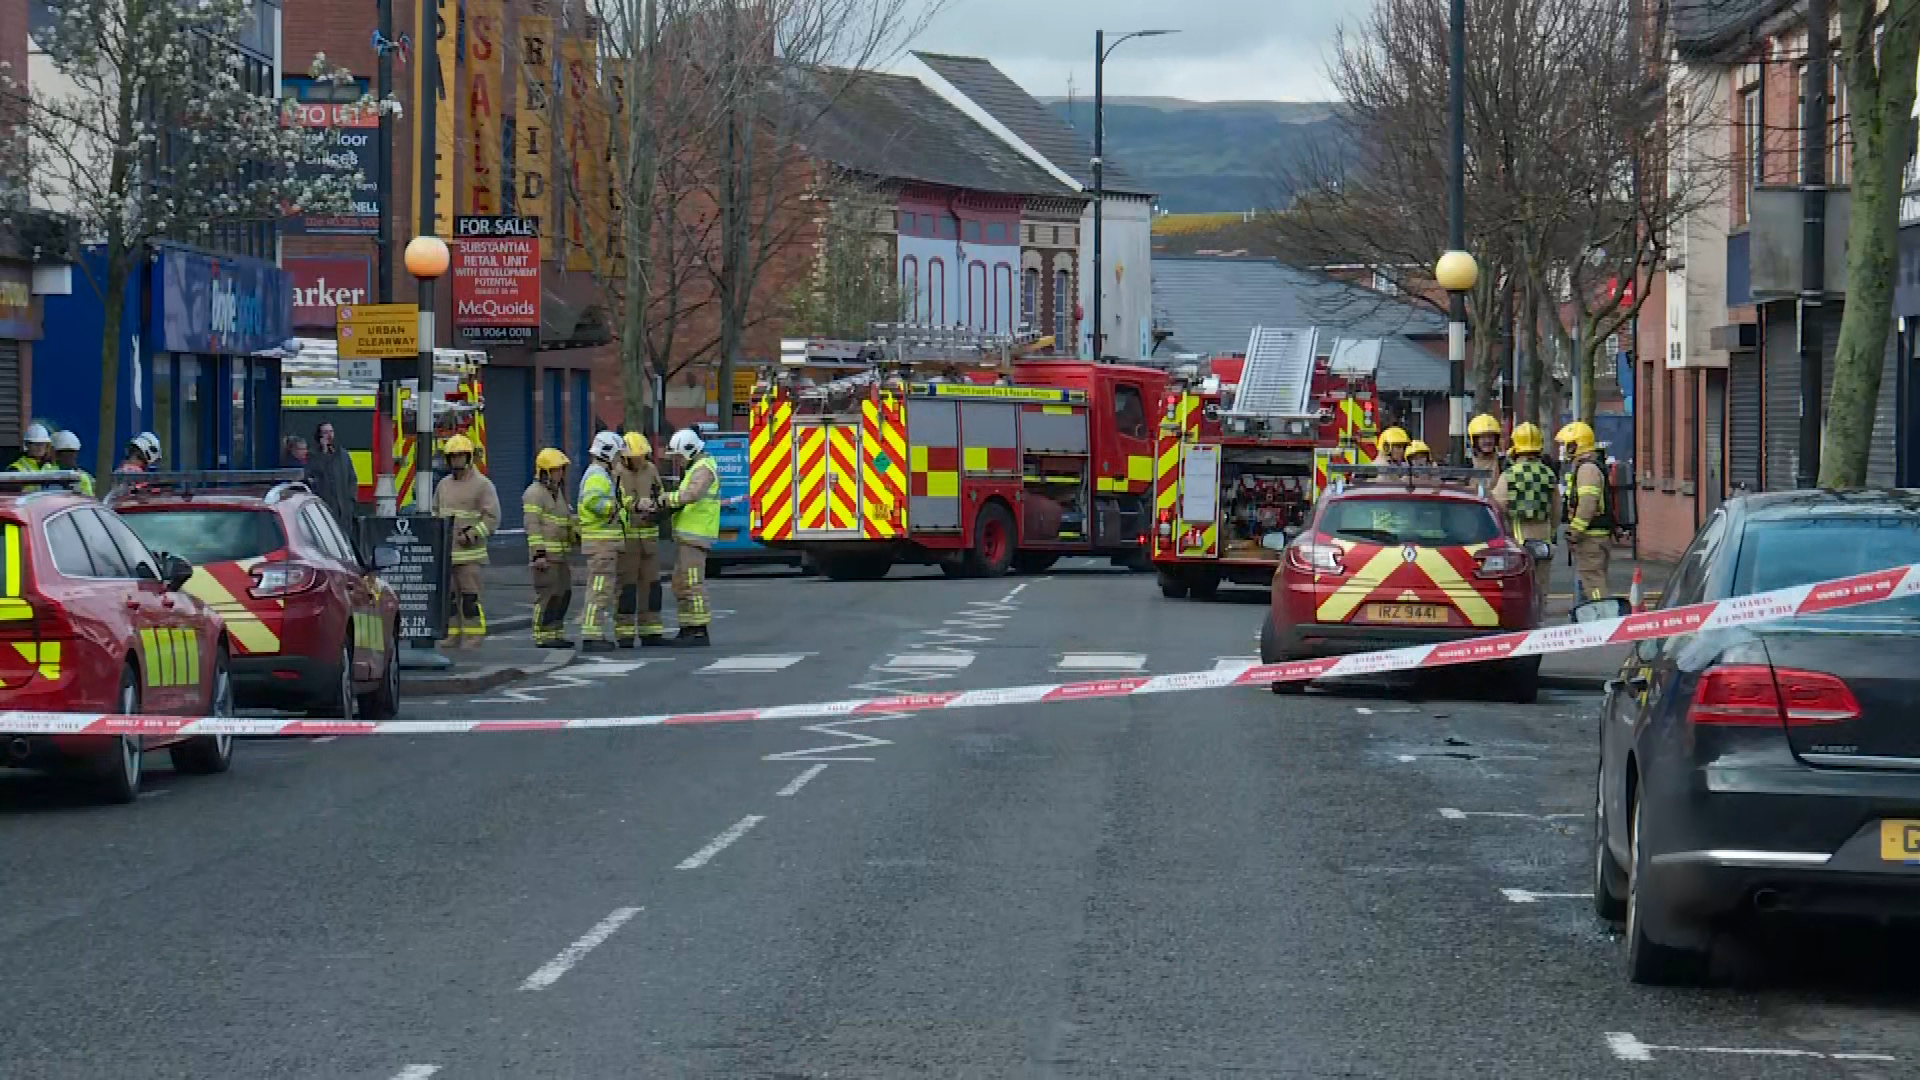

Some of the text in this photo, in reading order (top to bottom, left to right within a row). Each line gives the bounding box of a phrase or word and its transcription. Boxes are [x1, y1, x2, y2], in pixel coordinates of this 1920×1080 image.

[522, 37, 546, 199] REID
[460, 219, 533, 235] FOR SALE
[460, 241, 532, 253] SUBSTANTIAL
[463, 255, 529, 267] RETAIL UNIT
[474, 277, 518, 287] POTENTIAL
[292, 277, 365, 307] arker
[458, 299, 535, 317] McQuoids
[367, 325, 406, 335] URBAN
[462, 327, 481, 337] 028
[483, 327, 507, 337] 9064
[358, 337, 416, 347] CLEARWAY
[1379, 605, 1437, 619] IRZ 9441
